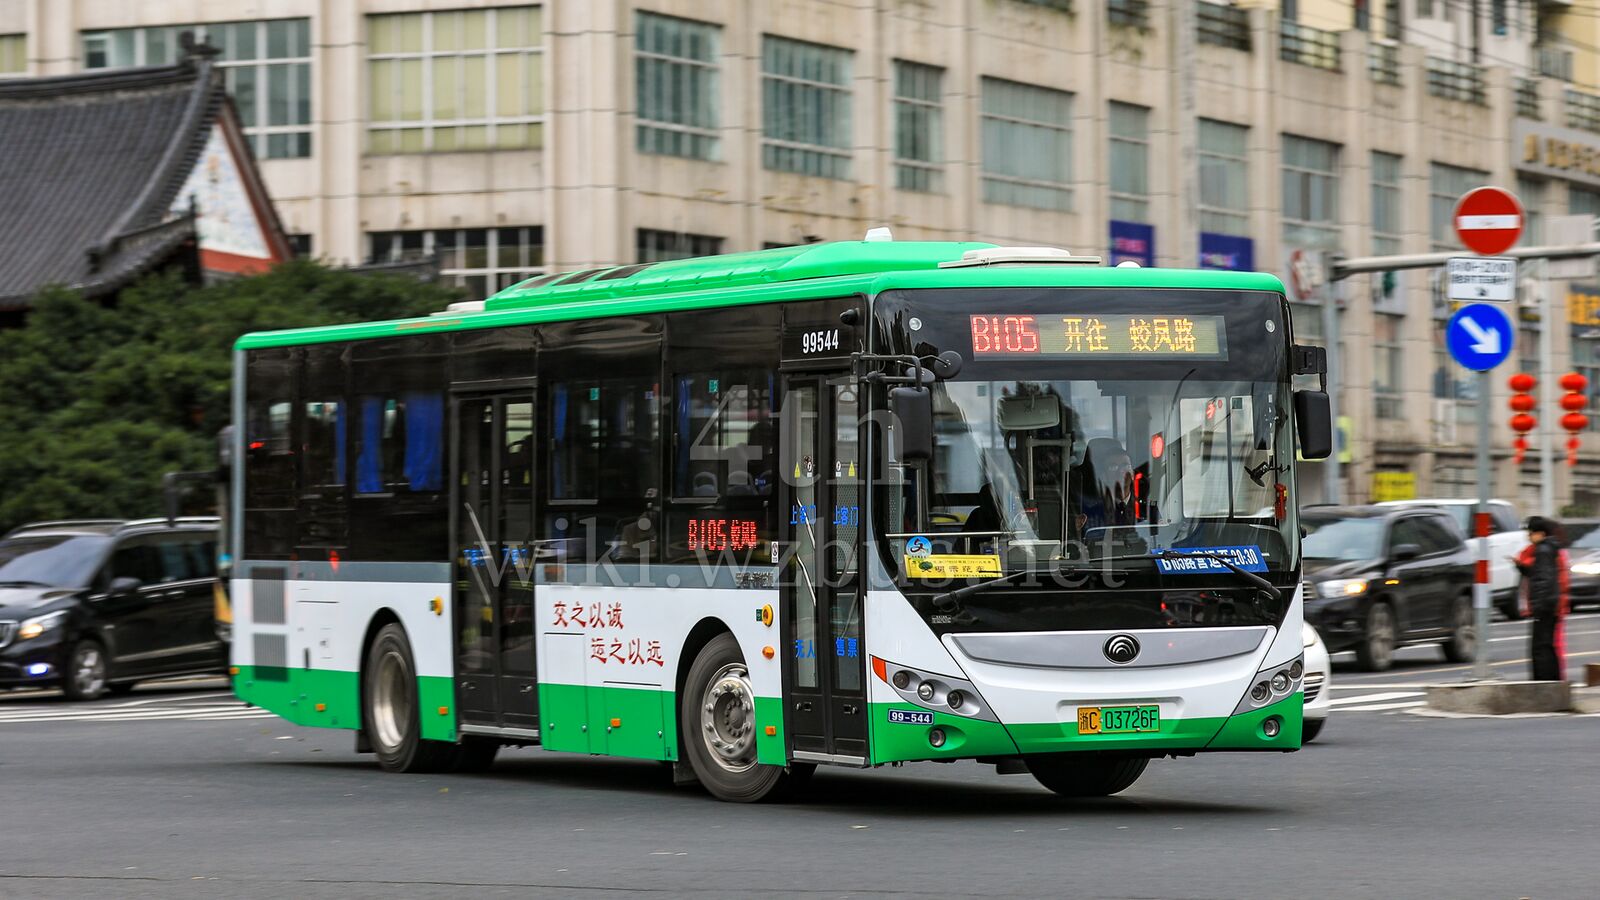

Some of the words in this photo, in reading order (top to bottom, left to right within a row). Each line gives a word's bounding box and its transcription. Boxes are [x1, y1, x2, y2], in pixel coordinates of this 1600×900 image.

[803, 329, 839, 354] 99544
[973, 317, 1038, 352] B105
[1063, 318, 1108, 352] 开往
[1129, 318, 1196, 352] 蛟凤路
[833, 505, 859, 527] 上客门
[688, 519, 726, 551] B105
[553, 601, 624, 629] 交之以诚
[590, 638, 664, 667] 运之以远
[795, 639, 816, 658] 无人
[836, 637, 858, 657] 售票
[891, 711, 930, 723] 99-544
[1105, 709, 1158, 729] 03726F
